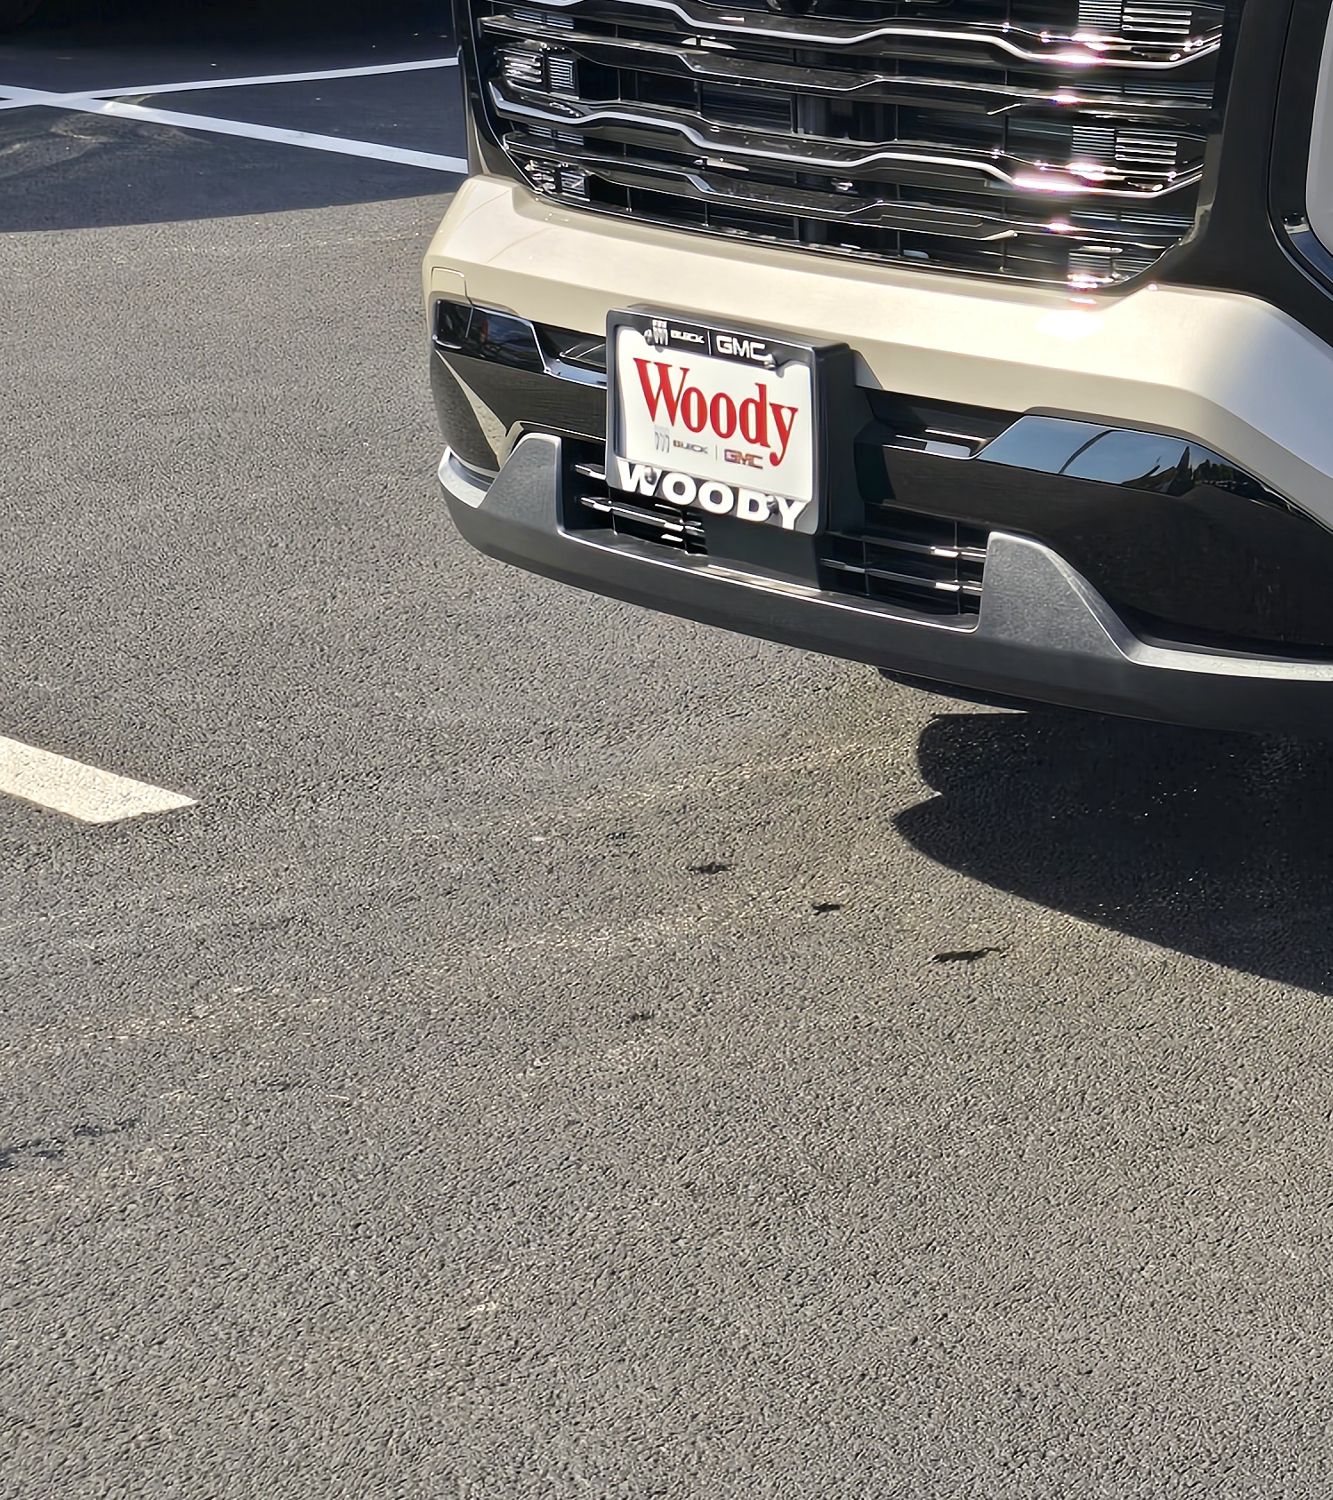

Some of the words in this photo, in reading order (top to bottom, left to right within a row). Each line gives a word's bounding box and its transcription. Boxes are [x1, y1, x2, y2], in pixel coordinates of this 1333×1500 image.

[715, 334, 769, 361] GMC
[632, 357, 799, 467] Woody
[724, 448, 764, 469] GMC
[616, 460, 808, 530] WOODY
